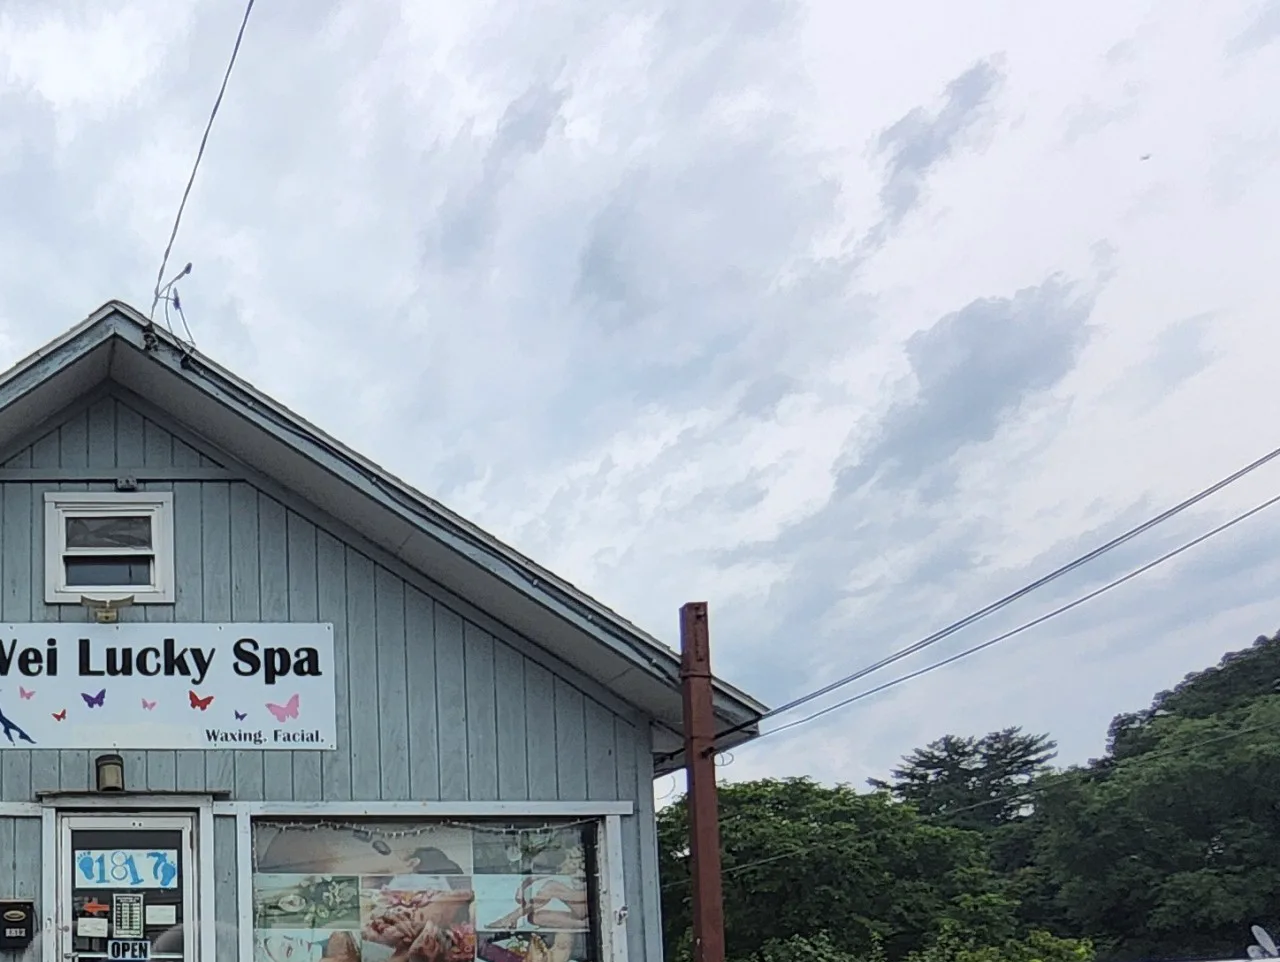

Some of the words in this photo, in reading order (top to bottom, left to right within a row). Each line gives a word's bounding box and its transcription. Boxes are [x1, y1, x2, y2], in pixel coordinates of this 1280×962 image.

[78, 638, 216, 685] Lucky
[232, 638, 323, 685] Spa
[111, 941, 149, 959] OPEN
